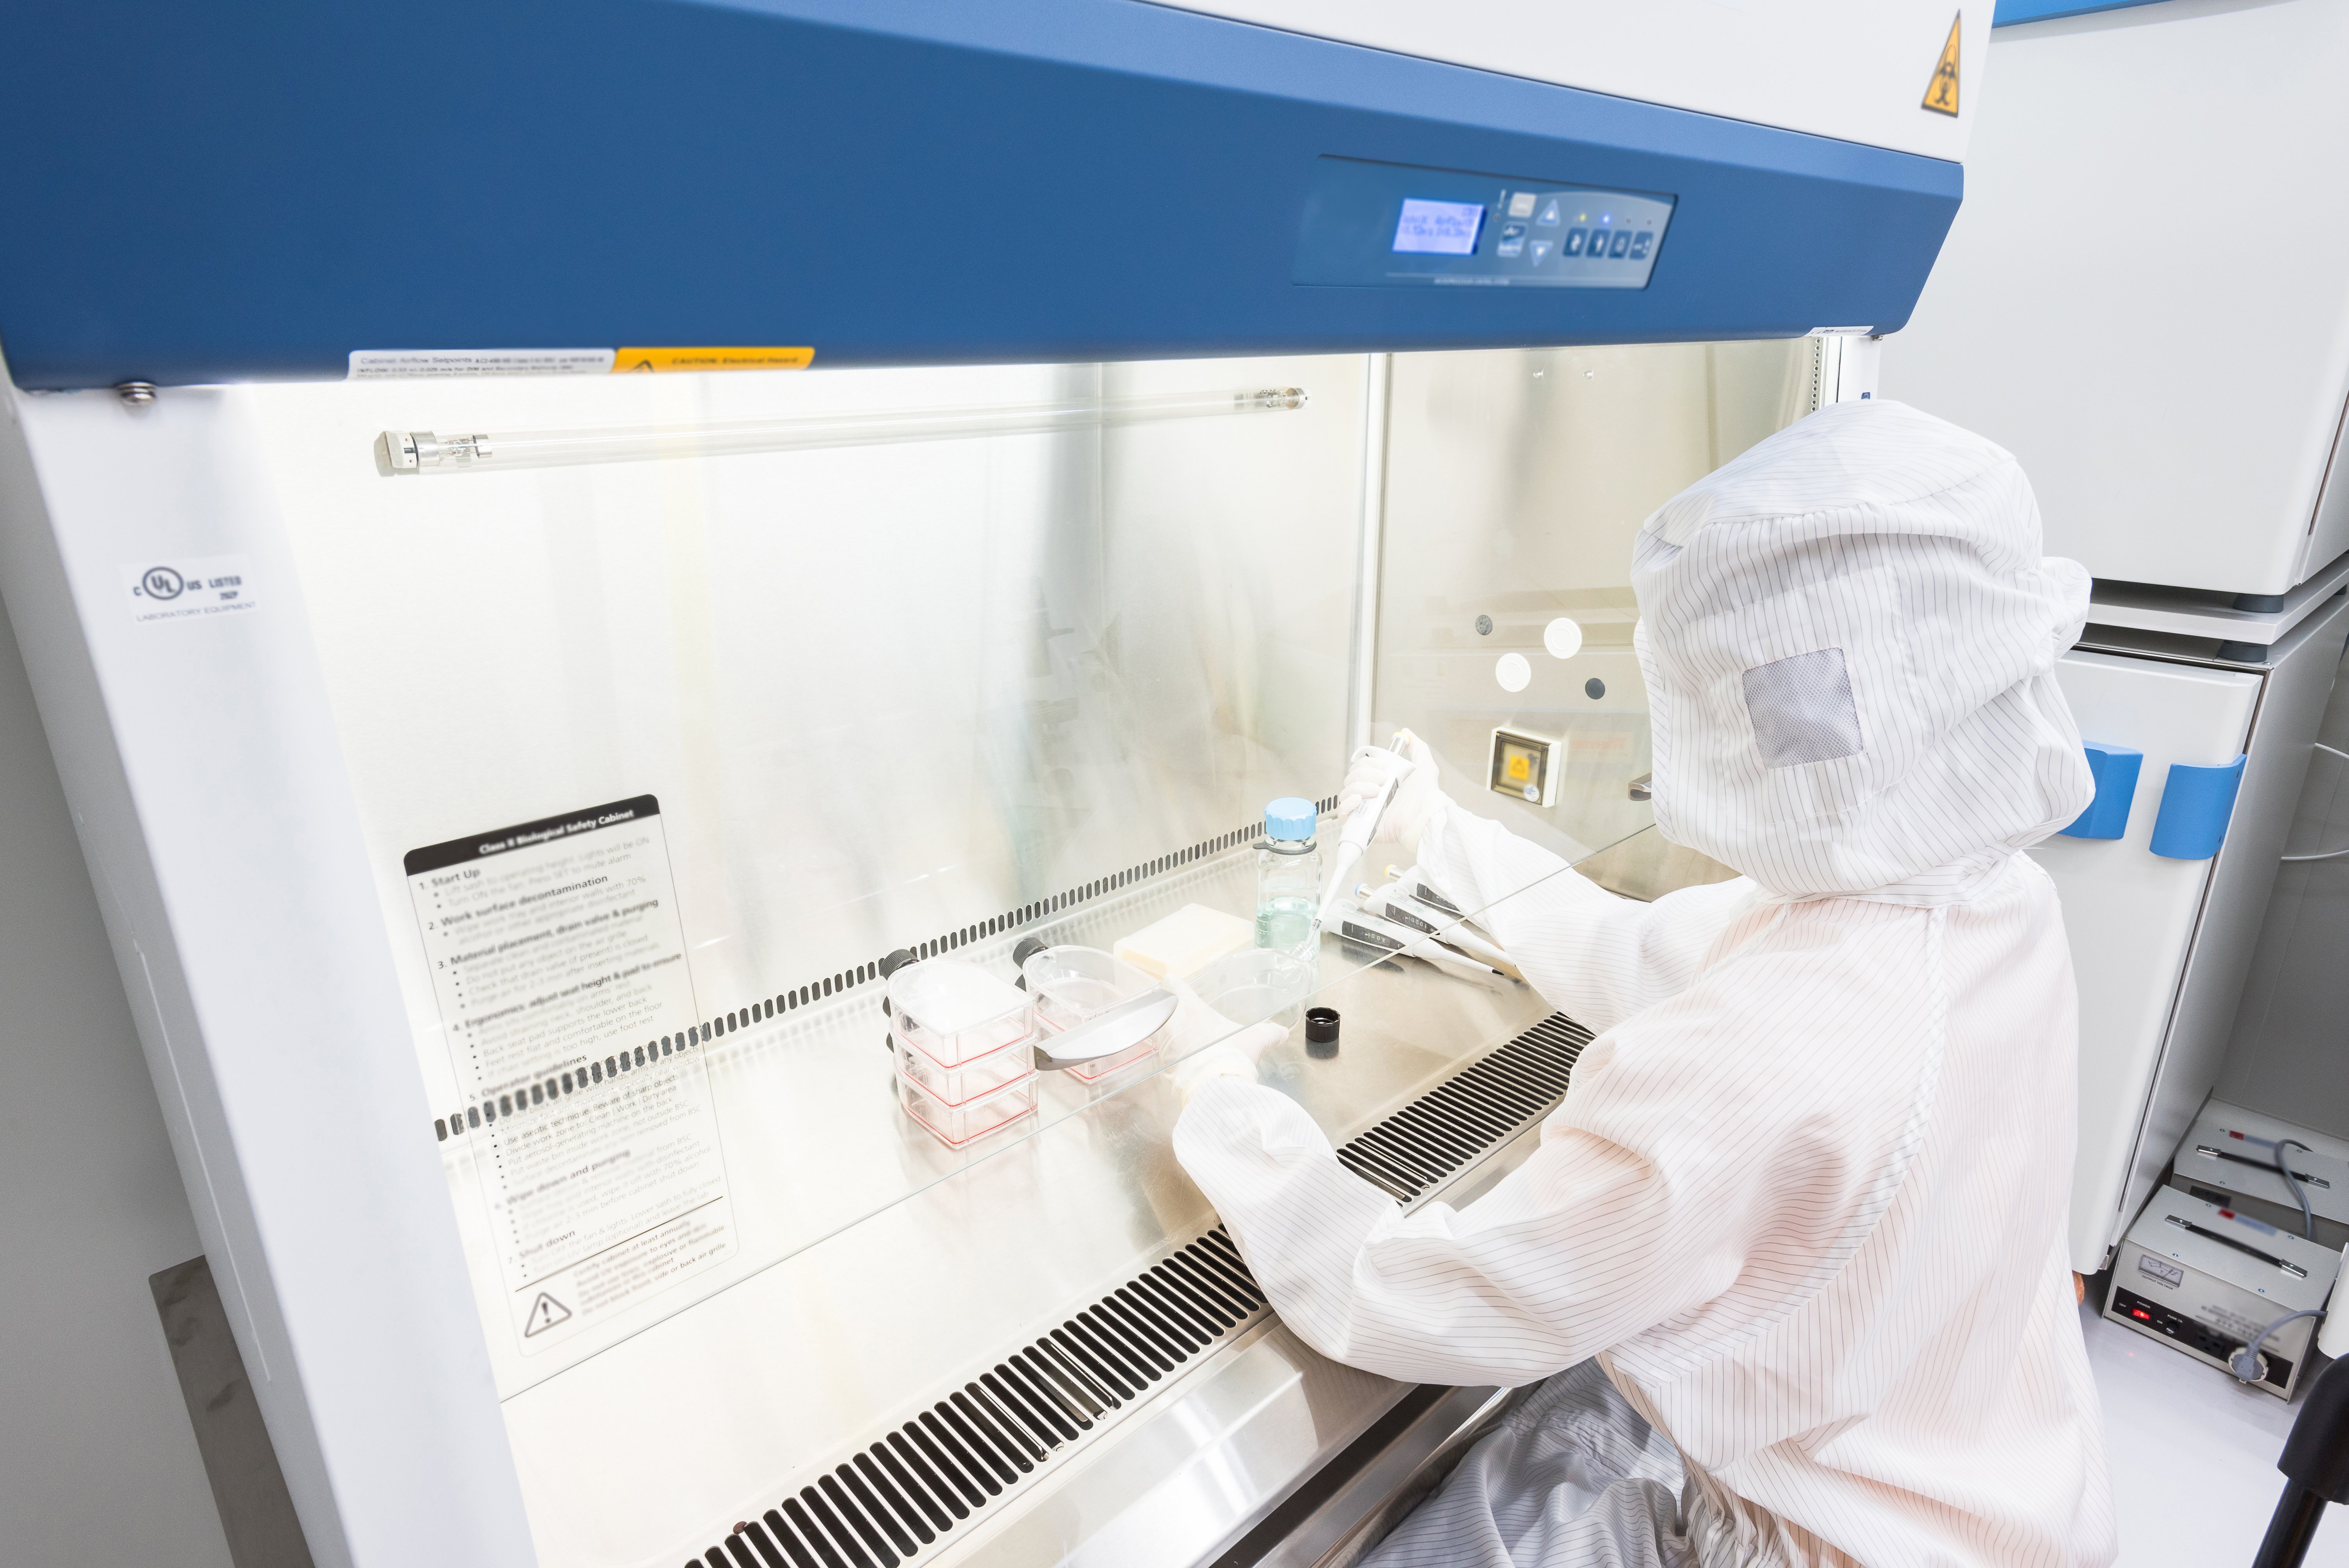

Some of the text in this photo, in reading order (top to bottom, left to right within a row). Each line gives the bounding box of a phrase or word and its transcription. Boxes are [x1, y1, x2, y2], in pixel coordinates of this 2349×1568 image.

[151, 574, 174, 593] UL
[187, 580, 202, 590] US
[137, 601, 255, 622] LABORATORY EQUIPMENT
[1525, 786, 1536, 795] QC
[566, 818, 597, 834] Safety
[598, 809, 634, 825] Cabinet
[606, 841, 633, 853] will be
[608, 852, 631, 864] alarm
[431, 873, 460, 887] Start
[463, 868, 481, 881] Up
[605, 875, 646, 892] with 70%
[440, 911, 471, 927] Work
[518, 874, 608, 905] decontamination
[437, 959, 447, 969] 3.
[621, 899, 658, 917] purging
[520, 966, 543, 979] drain
[545, 959, 567, 971] valve
[623, 934, 647, 948] closed
[587, 954, 622, 971] inserting
[581, 974, 612, 992] height
[615, 990, 631, 1001] and
[483, 996, 647, 1057] Back seat pad supports the lower back
[485, 1001, 663, 1067] Feet rest flat and comfortable on the floor
[563, 1015, 654, 1052] too use foot rest
[533, 1053, 587, 1080] guidelines
[585, 1081, 602, 1092] with
[631, 1065, 649, 1075] arms
[660, 1056, 673, 1066] any
[674, 1045, 699, 1061] objects
[557, 1055, 700, 1114] arm especially near window
[503, 1073, 679, 1146] Use aseptic Beware of sharp objects
[506, 1085, 676, 1156] Divide work zone Clean Work Dirty area
[637, 1104, 701, 1136] removed from BSC
[508, 1095, 673, 1166] Put machine on the back
[510, 1099, 688, 1176] Put waste bin inside work not outside BSC
[657, 1133, 692, 1153] from BSC
[570, 1165, 588, 1179] and
[643, 1145, 710, 1179] with 70% alcohol
[583, 1160, 699, 1216] min before cabinet shut down
[569, 1237, 581, 1248] the
[583, 1230, 596, 1241] fan
[656, 1197, 671, 1209] sash
[683, 1185, 697, 1198] fully
[699, 1175, 720, 1190] closed
[583, 1190, 708, 1254] lamp and leave the lab
[546, 1229, 575, 1247] down
[602, 1247, 629, 1264] cabinet
[641, 1234, 658, 1246] least
[650, 1238, 675, 1253] to eyes
[654, 1269, 668, 1281] side
[680, 1256, 696, 1268] back
[698, 1251, 707, 1260] air
[708, 1241, 726, 1256] grille
[2142, 1275, 2173, 1290] OUTPUT VOLTAGE
